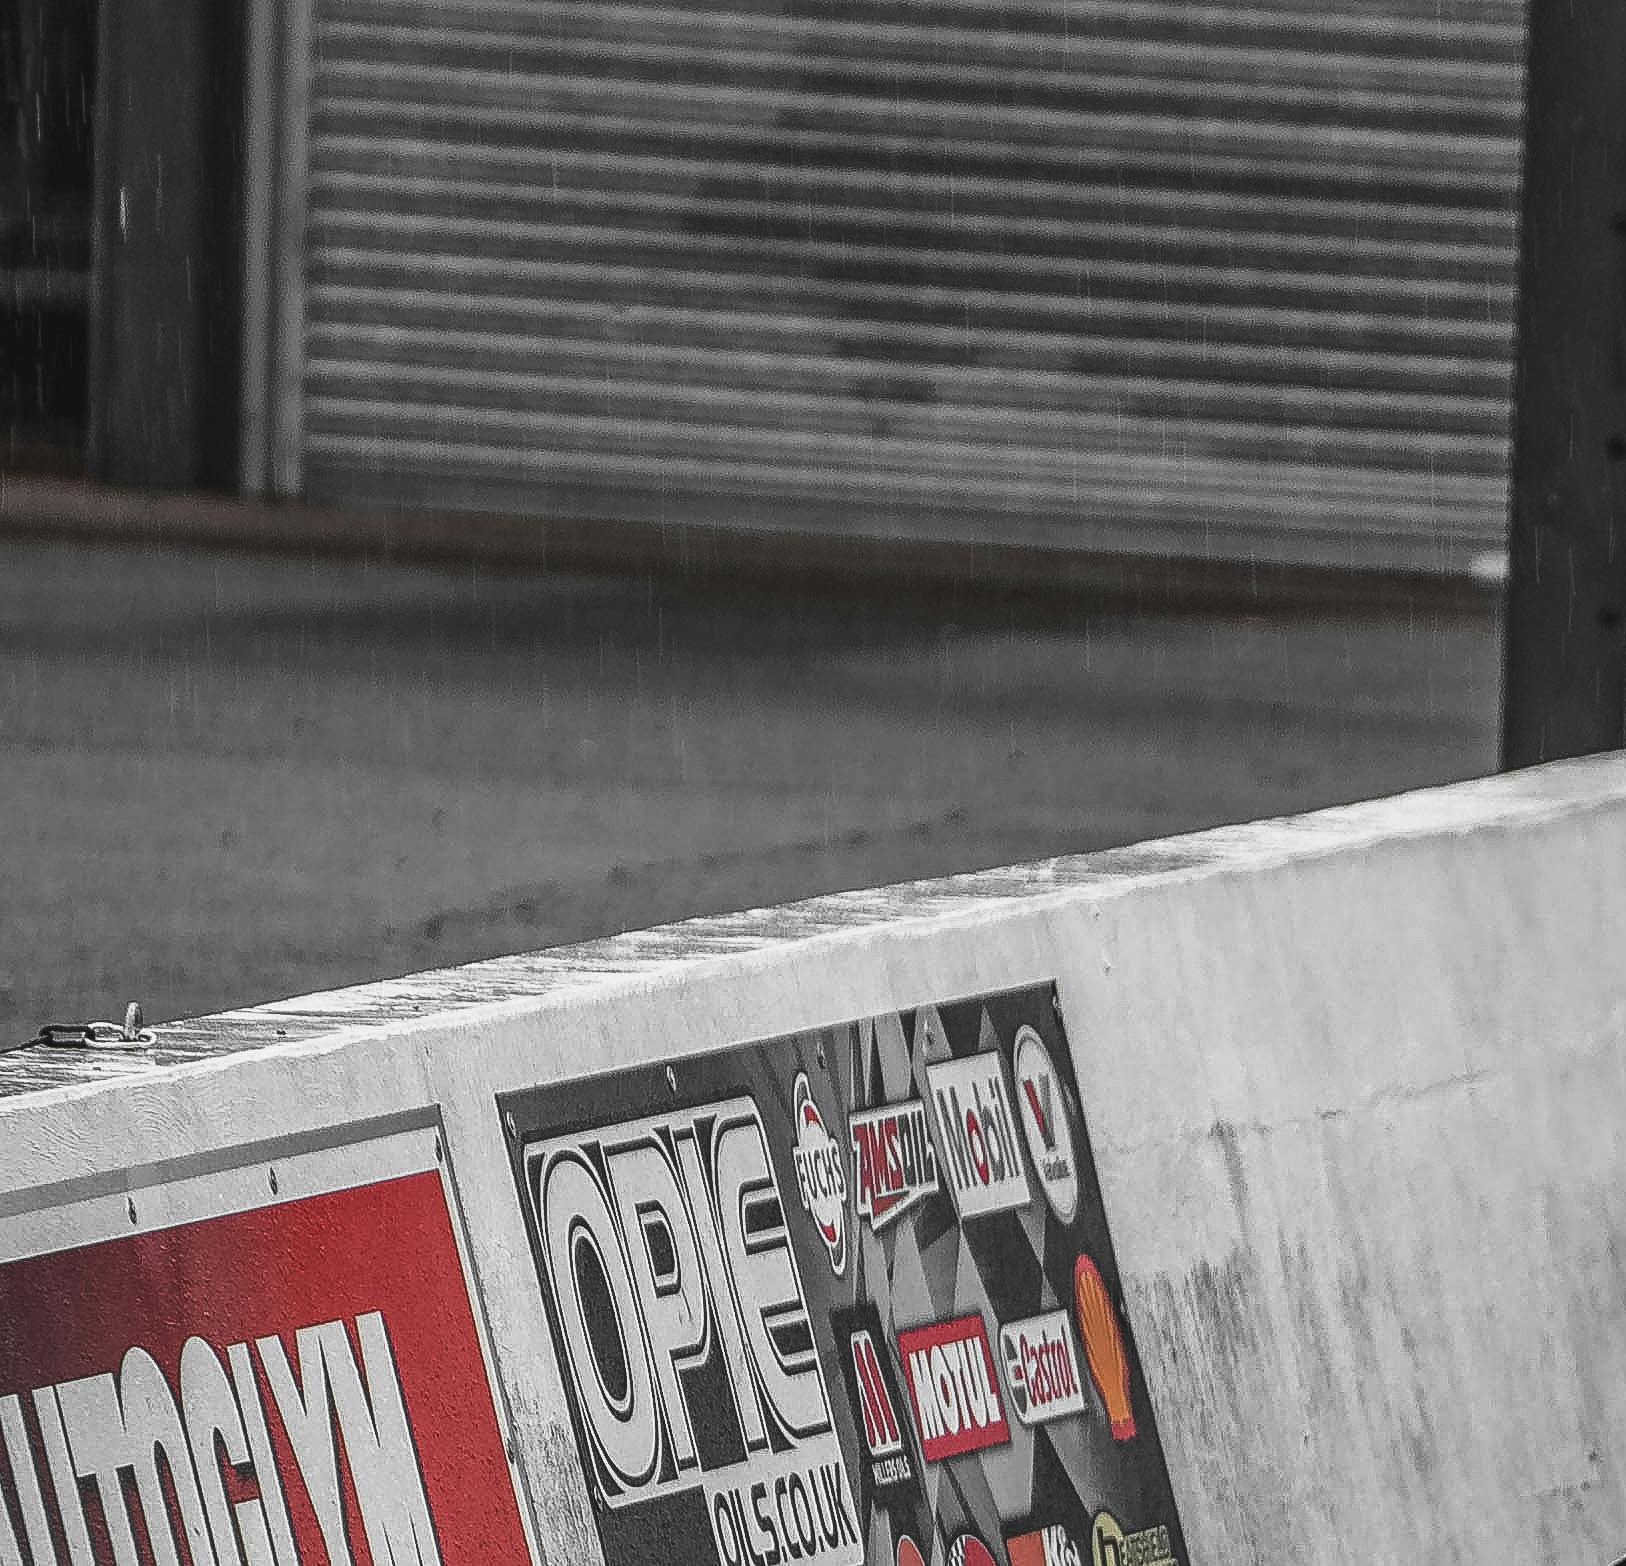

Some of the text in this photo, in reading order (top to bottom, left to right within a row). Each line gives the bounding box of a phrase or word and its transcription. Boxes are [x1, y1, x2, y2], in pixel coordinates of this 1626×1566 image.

[795, 1146, 845, 1198] FUCHS
[934, 1075, 1020, 1190] Mobil
[541, 1113, 833, 1488] OPIE
[908, 1335, 1001, 1440] MOTUL
[1020, 1324, 1078, 1408] Castrol
